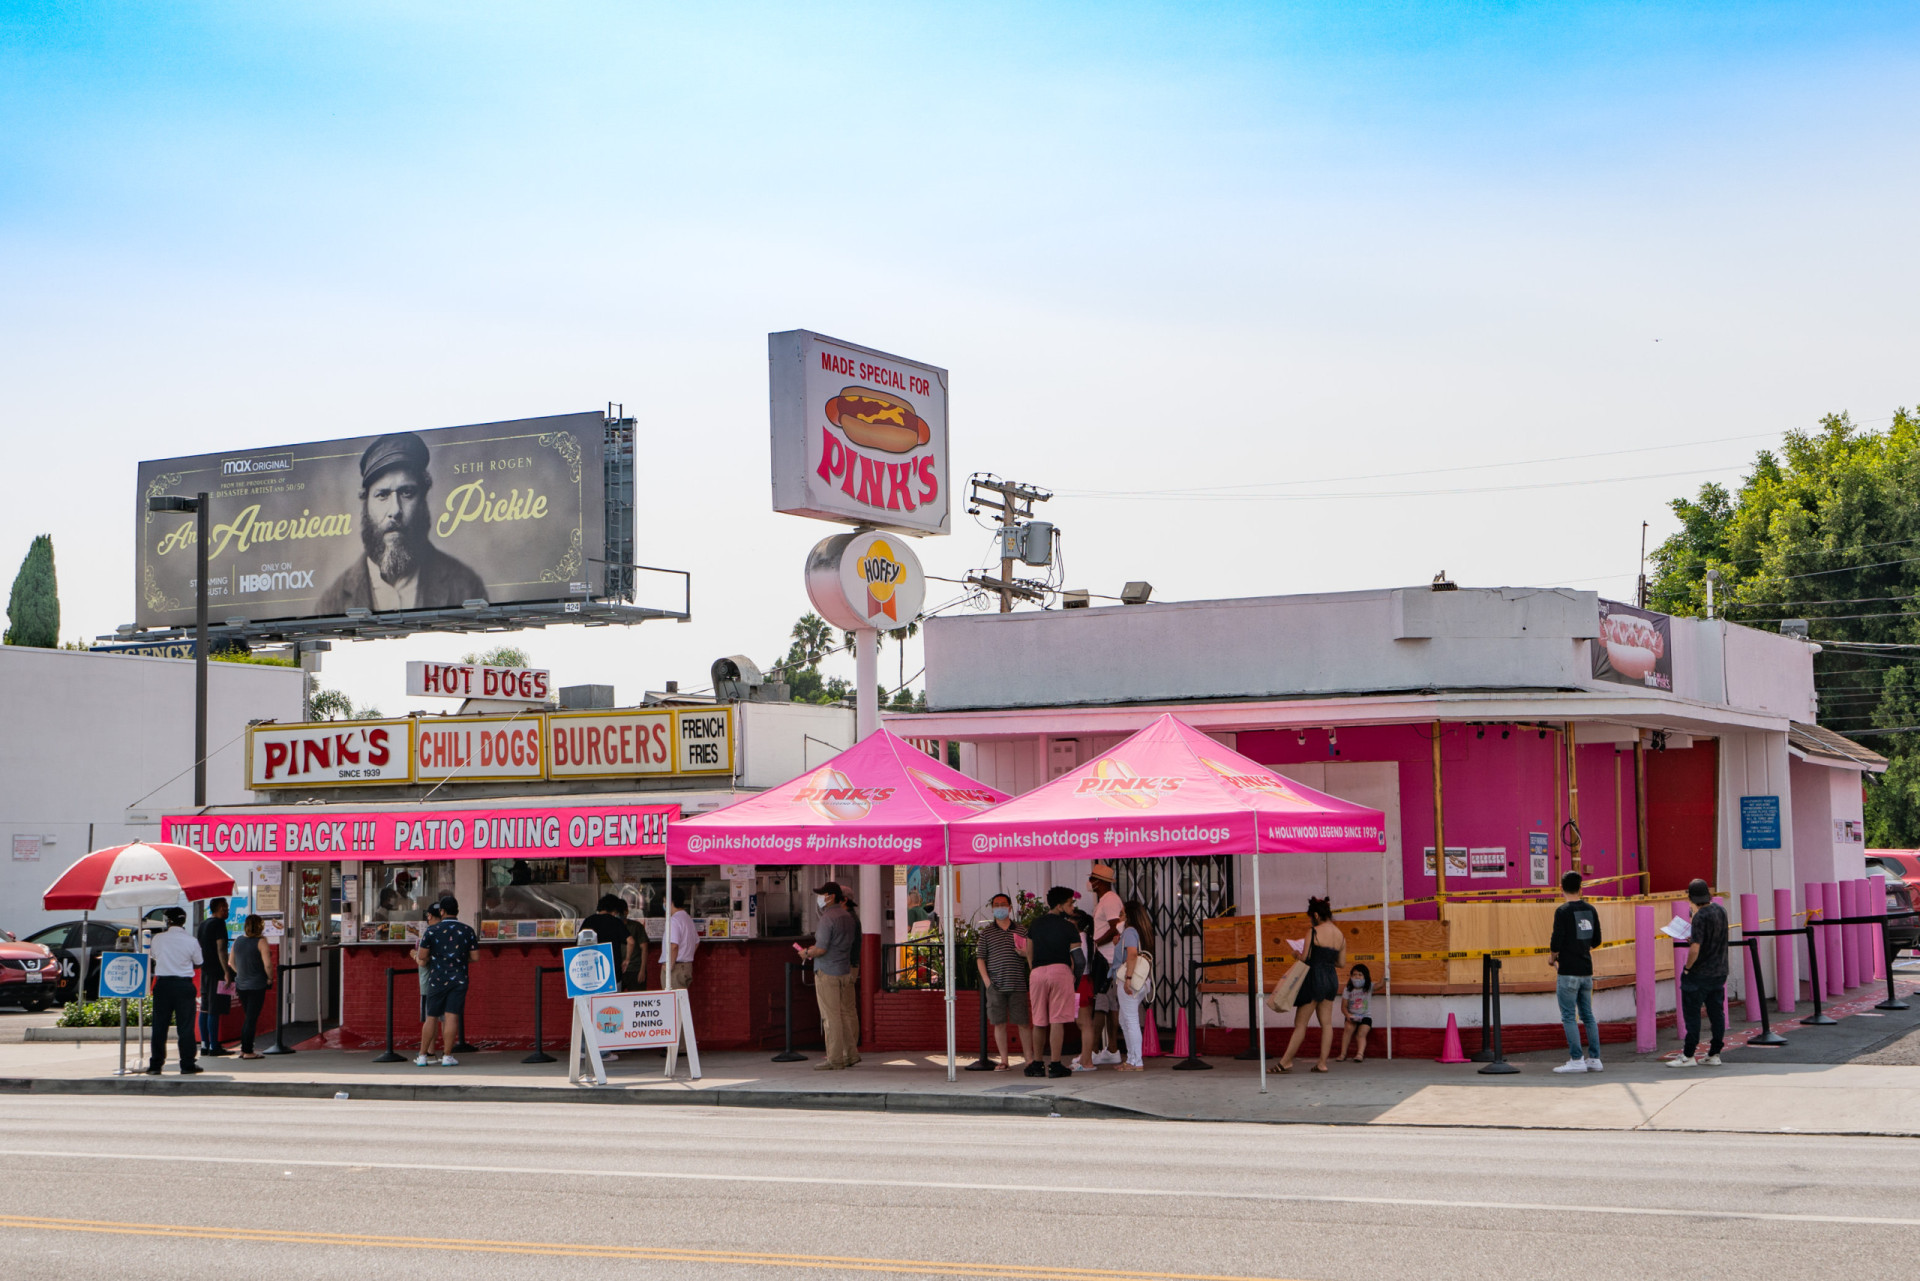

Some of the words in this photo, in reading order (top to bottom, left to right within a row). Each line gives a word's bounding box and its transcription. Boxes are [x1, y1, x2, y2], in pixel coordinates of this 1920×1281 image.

[821, 351, 856, 378] MADE
[859, 362, 906, 391] SPECIAL
[909, 376, 930, 397] FOR
[223, 459, 252, 474] max
[252, 459, 290, 472] ORIGINAL
[454, 461, 484, 474] SETH
[490, 457, 532, 471] ROGEN
[816, 425, 938, 511] PINK'S
[216, 489, 249, 498] DISASTER
[251, 486, 273, 495] ARTIST
[286, 483, 305, 491] 50/50
[247, 479, 277, 487] PRODUCERS
[436, 478, 549, 538] Pickle
[208, 504, 352, 561] American
[261, 563, 279, 572] ONLY
[281, 562, 292, 570] ON
[864, 558, 900, 583] HOFFY
[189, 576, 229, 588] STAMING
[223, 586, 229, 595] 6
[565, 603, 579, 612] 424
[424, 664, 474, 695] HOT
[483, 668, 548, 699] DOGS
[682, 717, 725, 739] FRENCH
[419, 731, 471, 768] CHILI
[480, 728, 539, 767] DOGS
[553, 723, 667, 767] BURGERS
[689, 743, 719, 764] FRIES
[264, 728, 390, 780] PINK'S
[338, 769, 361, 778] SINCE
[363, 768, 381, 778] 1939
[1075, 777, 1185, 794] PINK'S
[1218, 774, 1284, 790] PINK'S
[792, 787, 897, 802] PINK'S
[926, 786, 996, 804] PINK'S
[170, 822, 278, 853] WELCOME
[285, 821, 347, 852] BACK
[394, 819, 465, 851] PATIO
[473, 816, 561, 849] DINING
[568, 814, 638, 848] OPEN
[971, 831, 1099, 853] @pinkshotdogs
[1103, 825, 1230, 846] #pinkshotdogs
[1269, 826, 1275, 839] A
[1275, 826, 1318, 838] HOLLYWOOD
[1319, 826, 1343, 838] LEGEND
[1344, 826, 1361, 838] SINCE
[1363, 826, 1377, 838] 1939
[687, 834, 803, 853] @pinkshotdogs
[806, 833, 922, 853] #pinkshotdogs
[114, 872, 168, 885] PINK'S
[633, 999, 661, 1008] PINK'S
[635, 1010, 660, 1018] PATIO
[632, 1019, 663, 1028] DINING
[624, 1030, 646, 1038] NOW
[648, 1028, 671, 1037] OPEN
